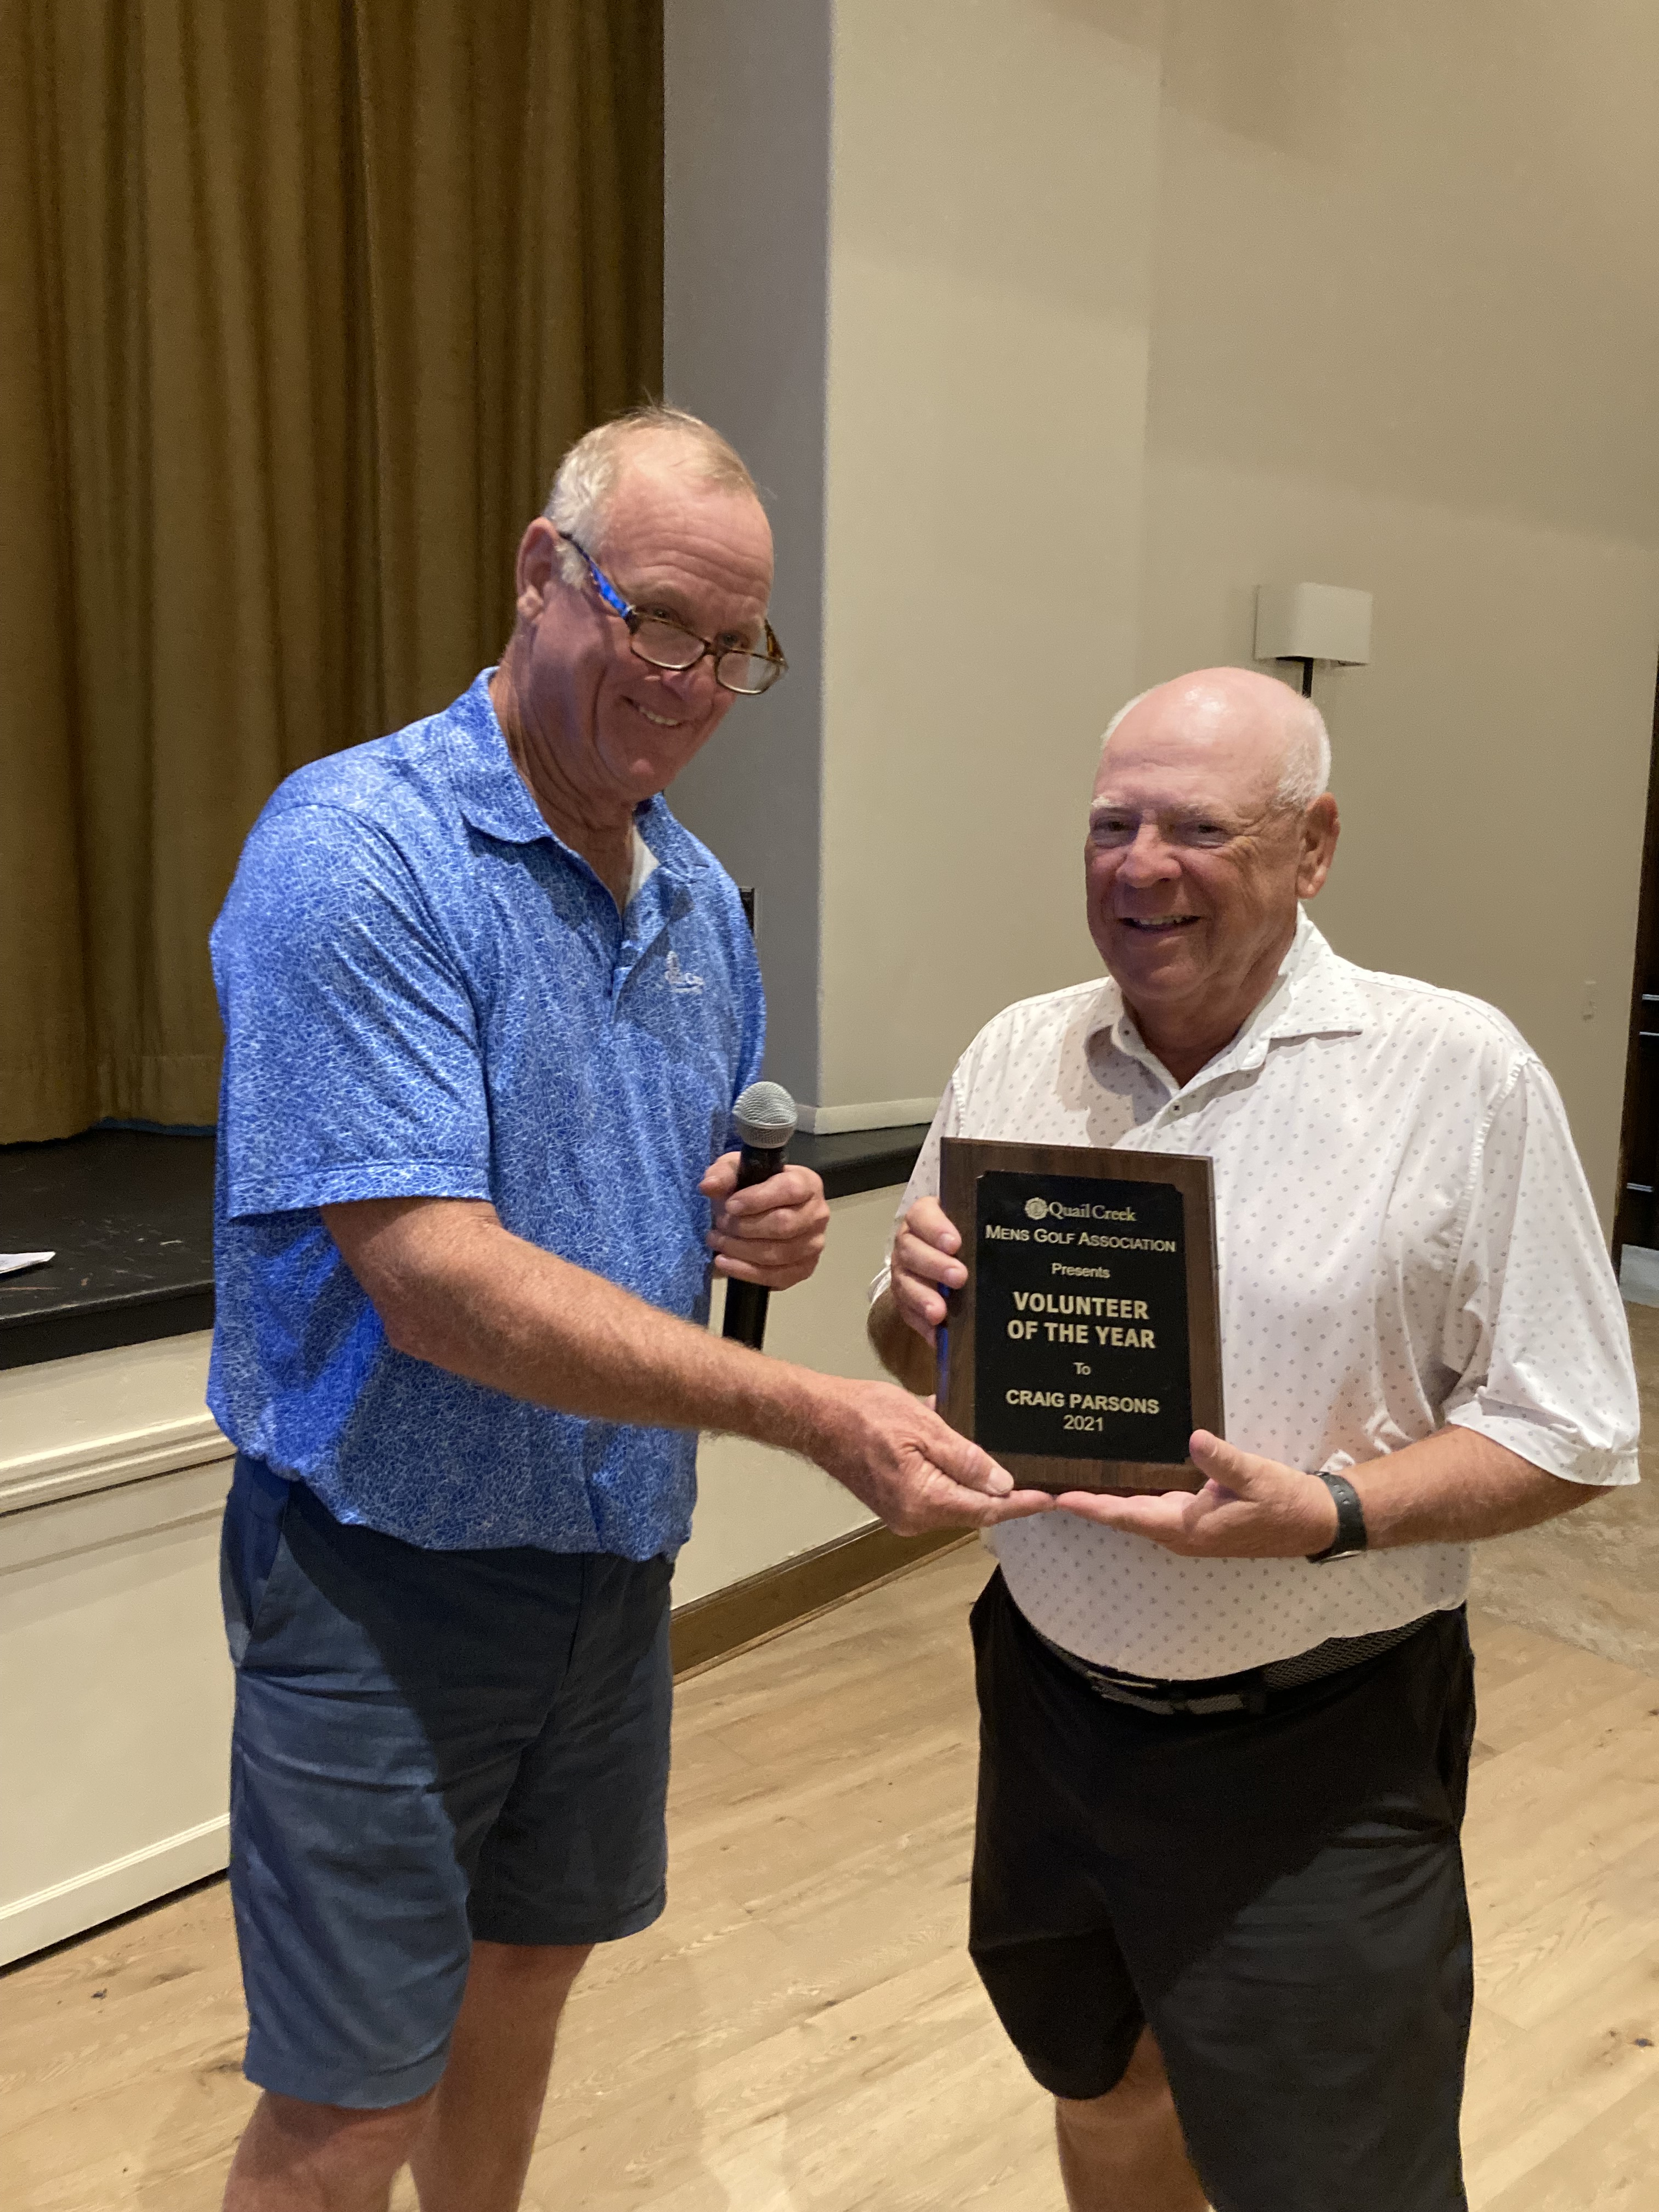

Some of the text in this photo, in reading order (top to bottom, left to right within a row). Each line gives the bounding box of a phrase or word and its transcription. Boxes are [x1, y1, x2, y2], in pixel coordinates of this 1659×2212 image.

[1048, 1201, 1137, 1222] Quail Creek
[985, 1224, 1176, 1252] MENS GOLF ASSOCIATION
[1051, 1262, 1110, 1279] Presents
[1013, 1291, 1149, 1320] VOLUNTEER
[1007, 1319, 1156, 1349] OF THE YEAR
[1073, 1362, 1091, 1375] To
[1006, 1389, 1160, 1414] CRAIG PARSONS
[1063, 1414, 1103, 1431] 2021
